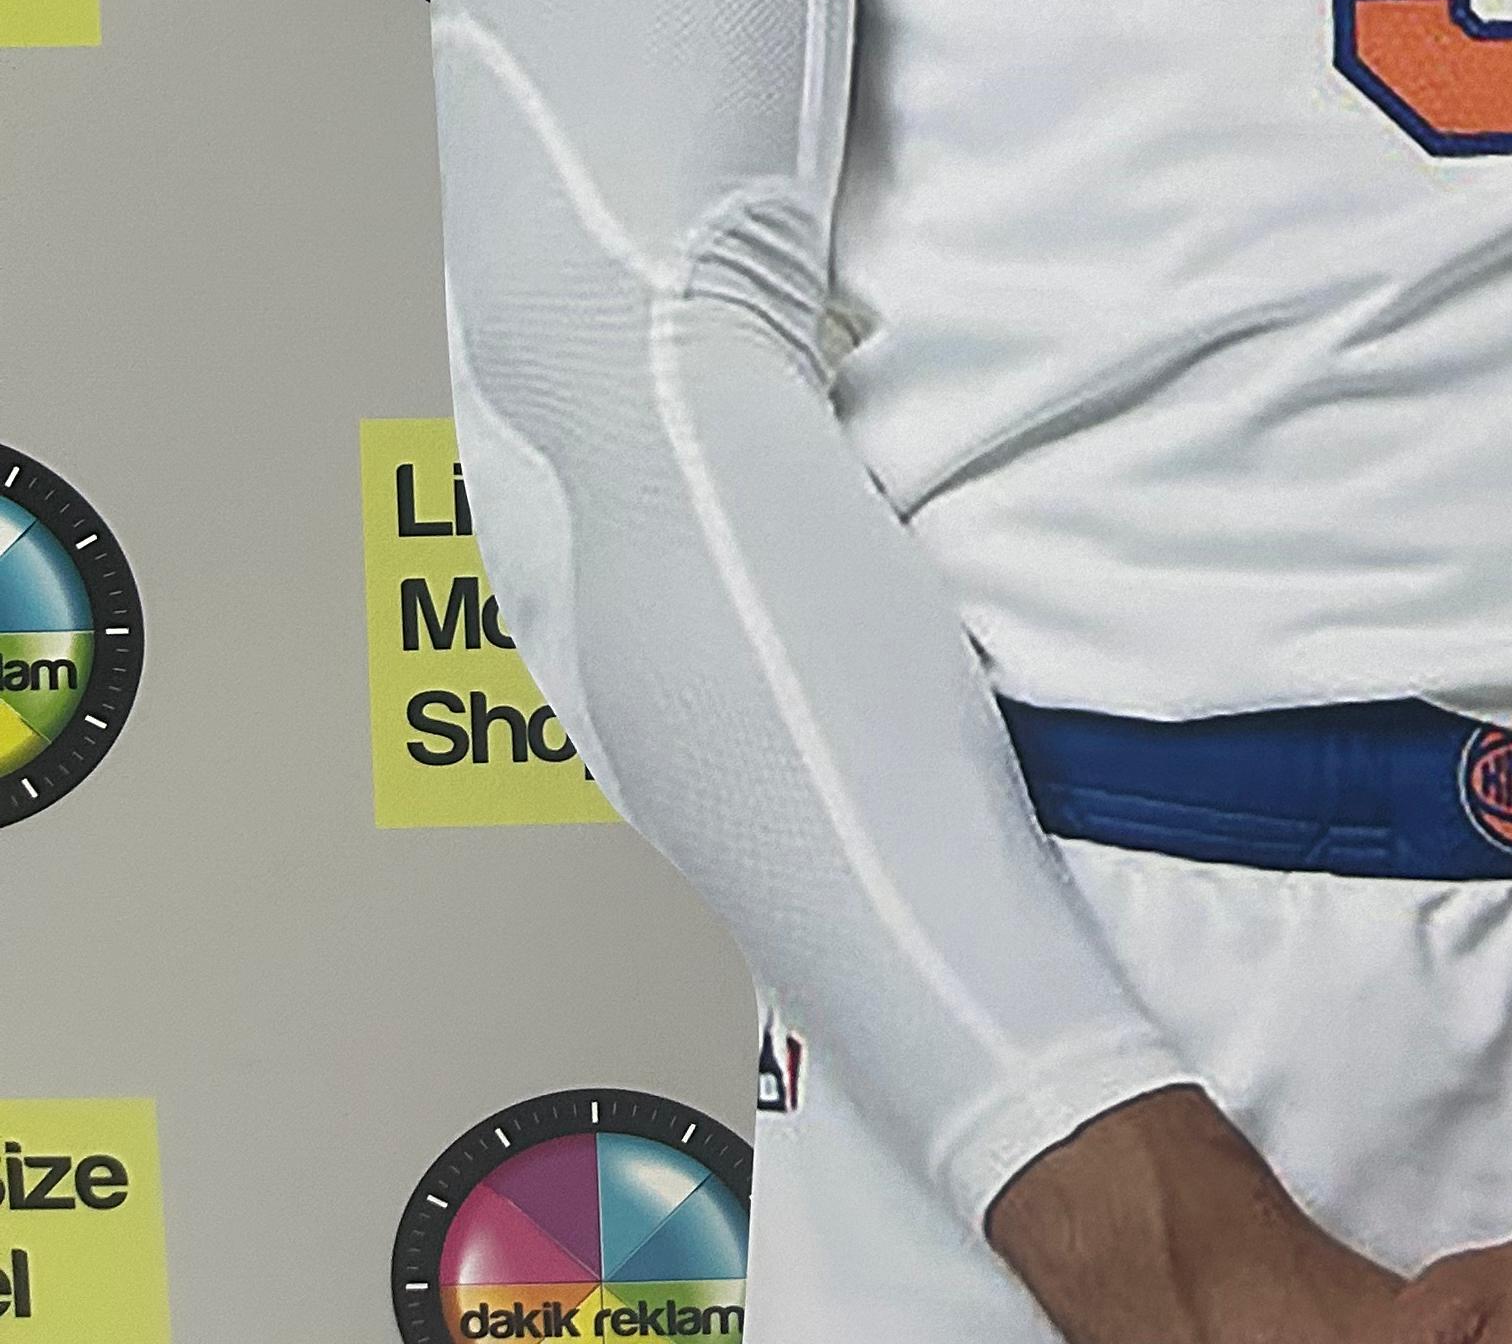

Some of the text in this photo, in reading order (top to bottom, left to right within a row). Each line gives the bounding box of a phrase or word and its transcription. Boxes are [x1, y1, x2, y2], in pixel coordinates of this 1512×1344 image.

[396, 462, 473, 538] Li
[406, 690, 595, 781] Sho
[0, 1141, 128, 1211] ize
[459, 1299, 745, 1339] dakik reklam
